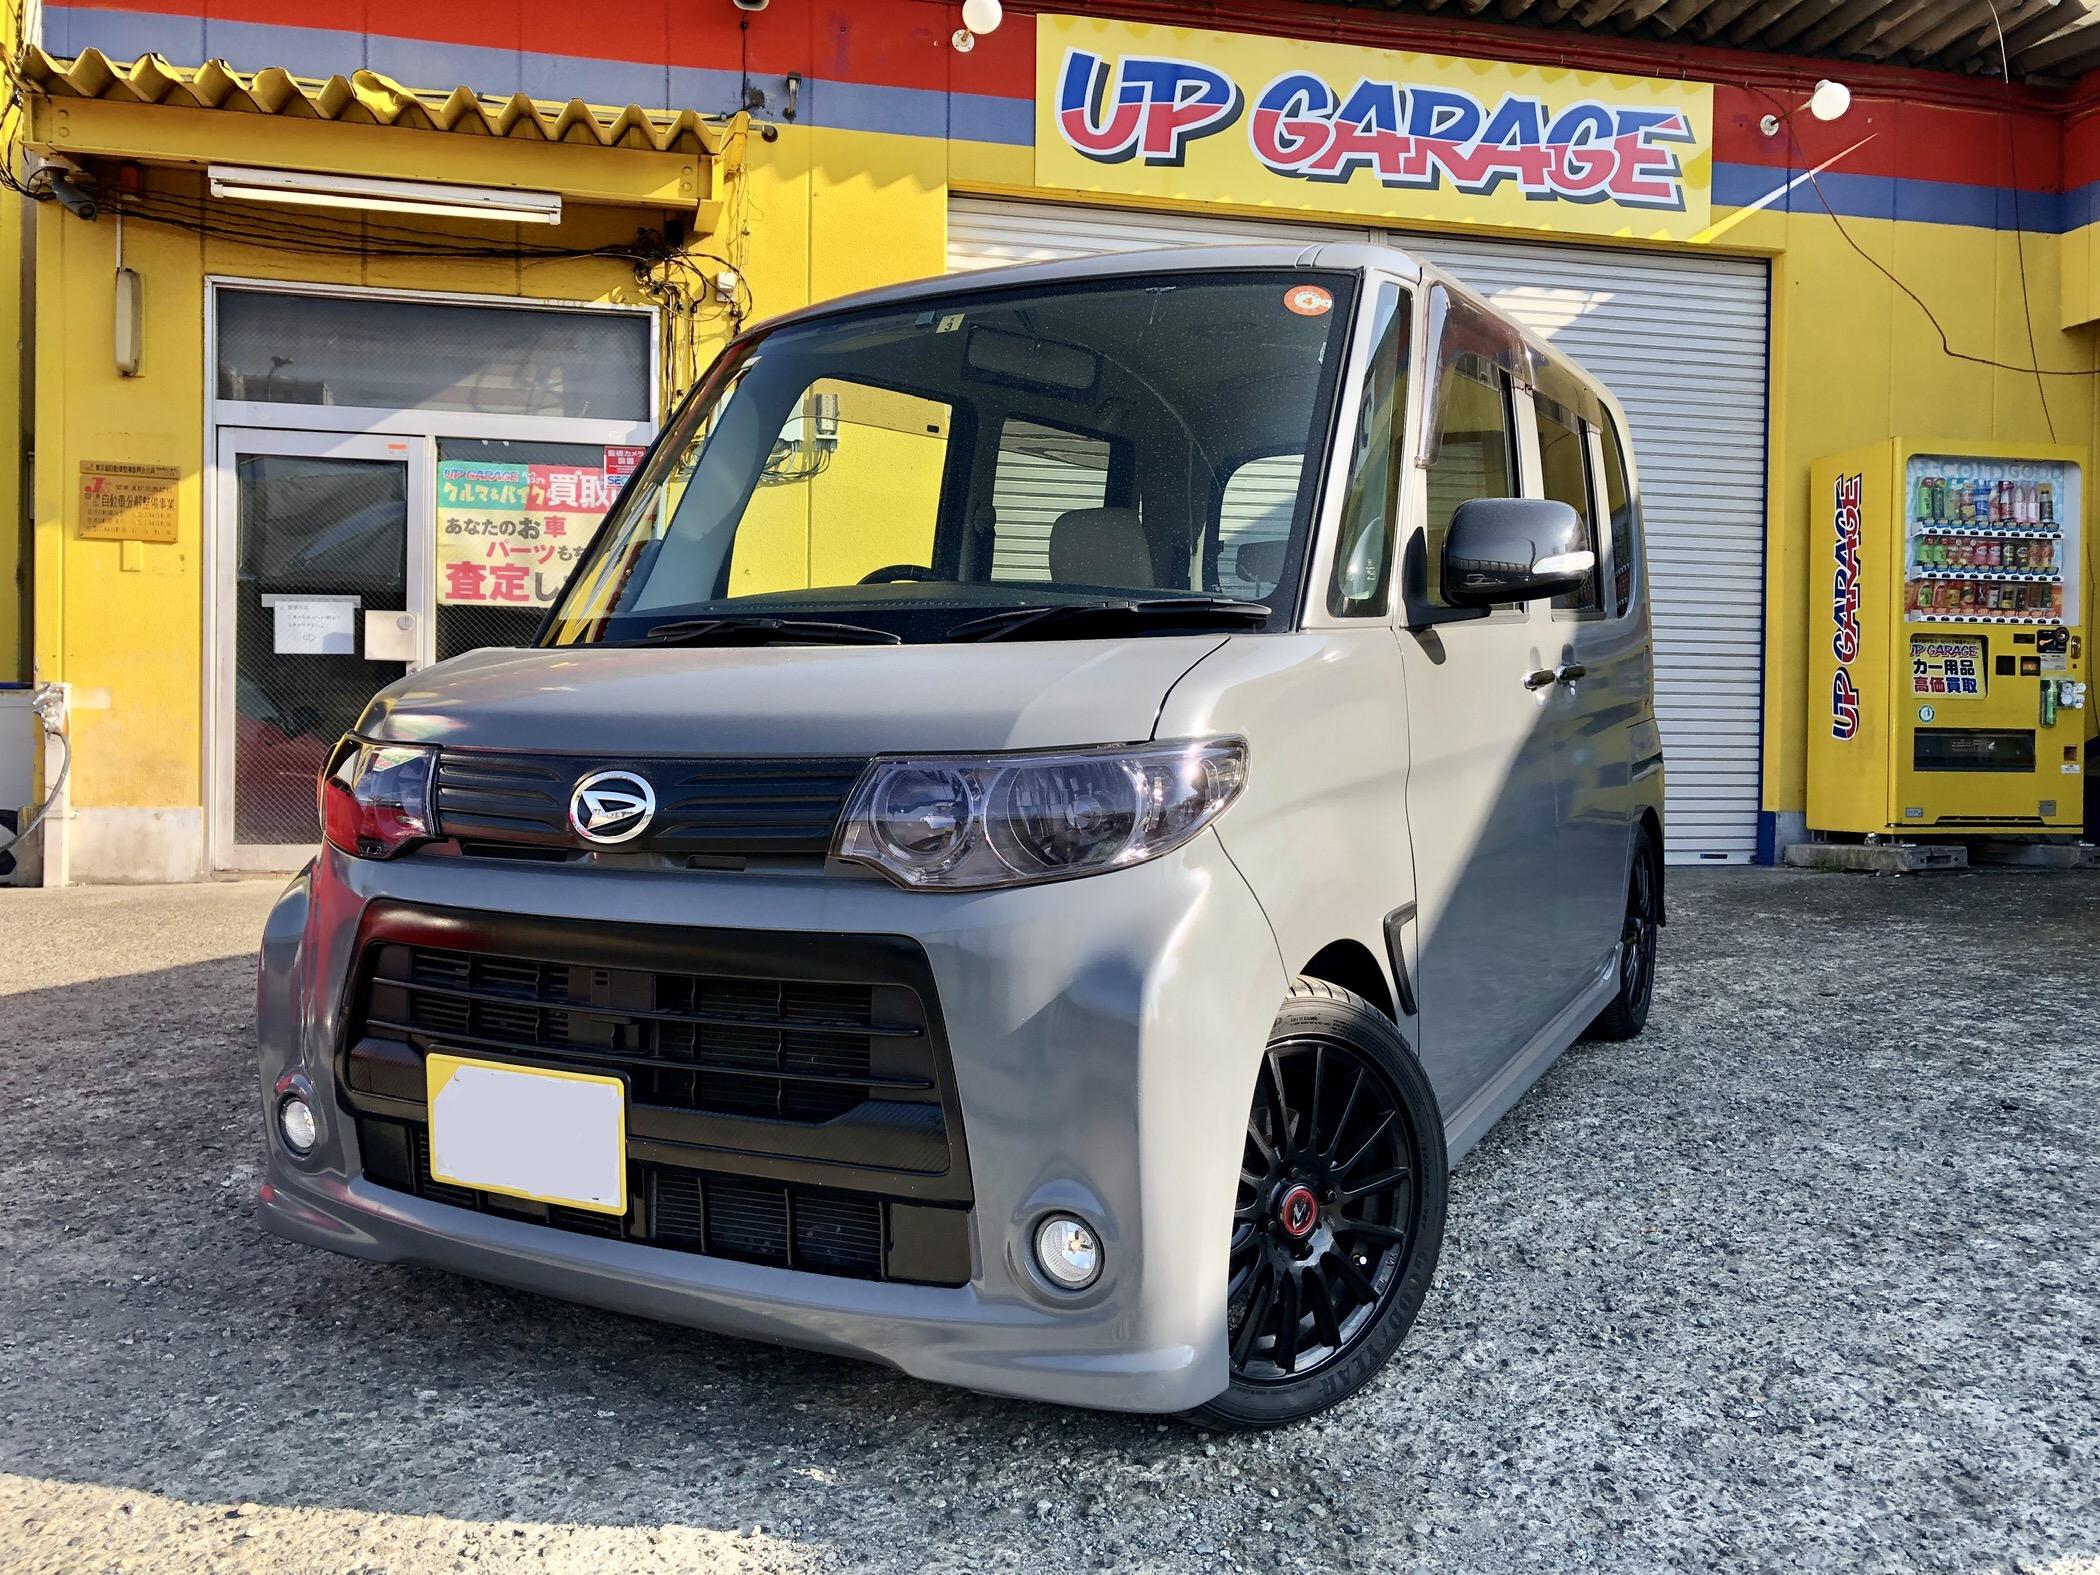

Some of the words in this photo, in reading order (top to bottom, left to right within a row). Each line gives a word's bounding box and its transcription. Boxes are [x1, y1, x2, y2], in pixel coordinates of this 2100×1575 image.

[1054, 47, 1245, 167] UP
[1247, 70, 1696, 212] GARAGE
[944, 322, 953, 331] 3
[444, 469, 463, 480] UP
[466, 470, 519, 482] GARAGE
[548, 470, 620, 508] 買取
[445, 515, 567, 540] あなたのお車
[445, 560, 568, 602] 査定し
[1832, 472, 1862, 666] GARAGE
[1926, 644, 1979, 658] GARAGE
[1912, 658, 1976, 676] カー用品
[1913, 675, 1979, 694] 高価買取
[1831, 667, 1860, 741] UP
